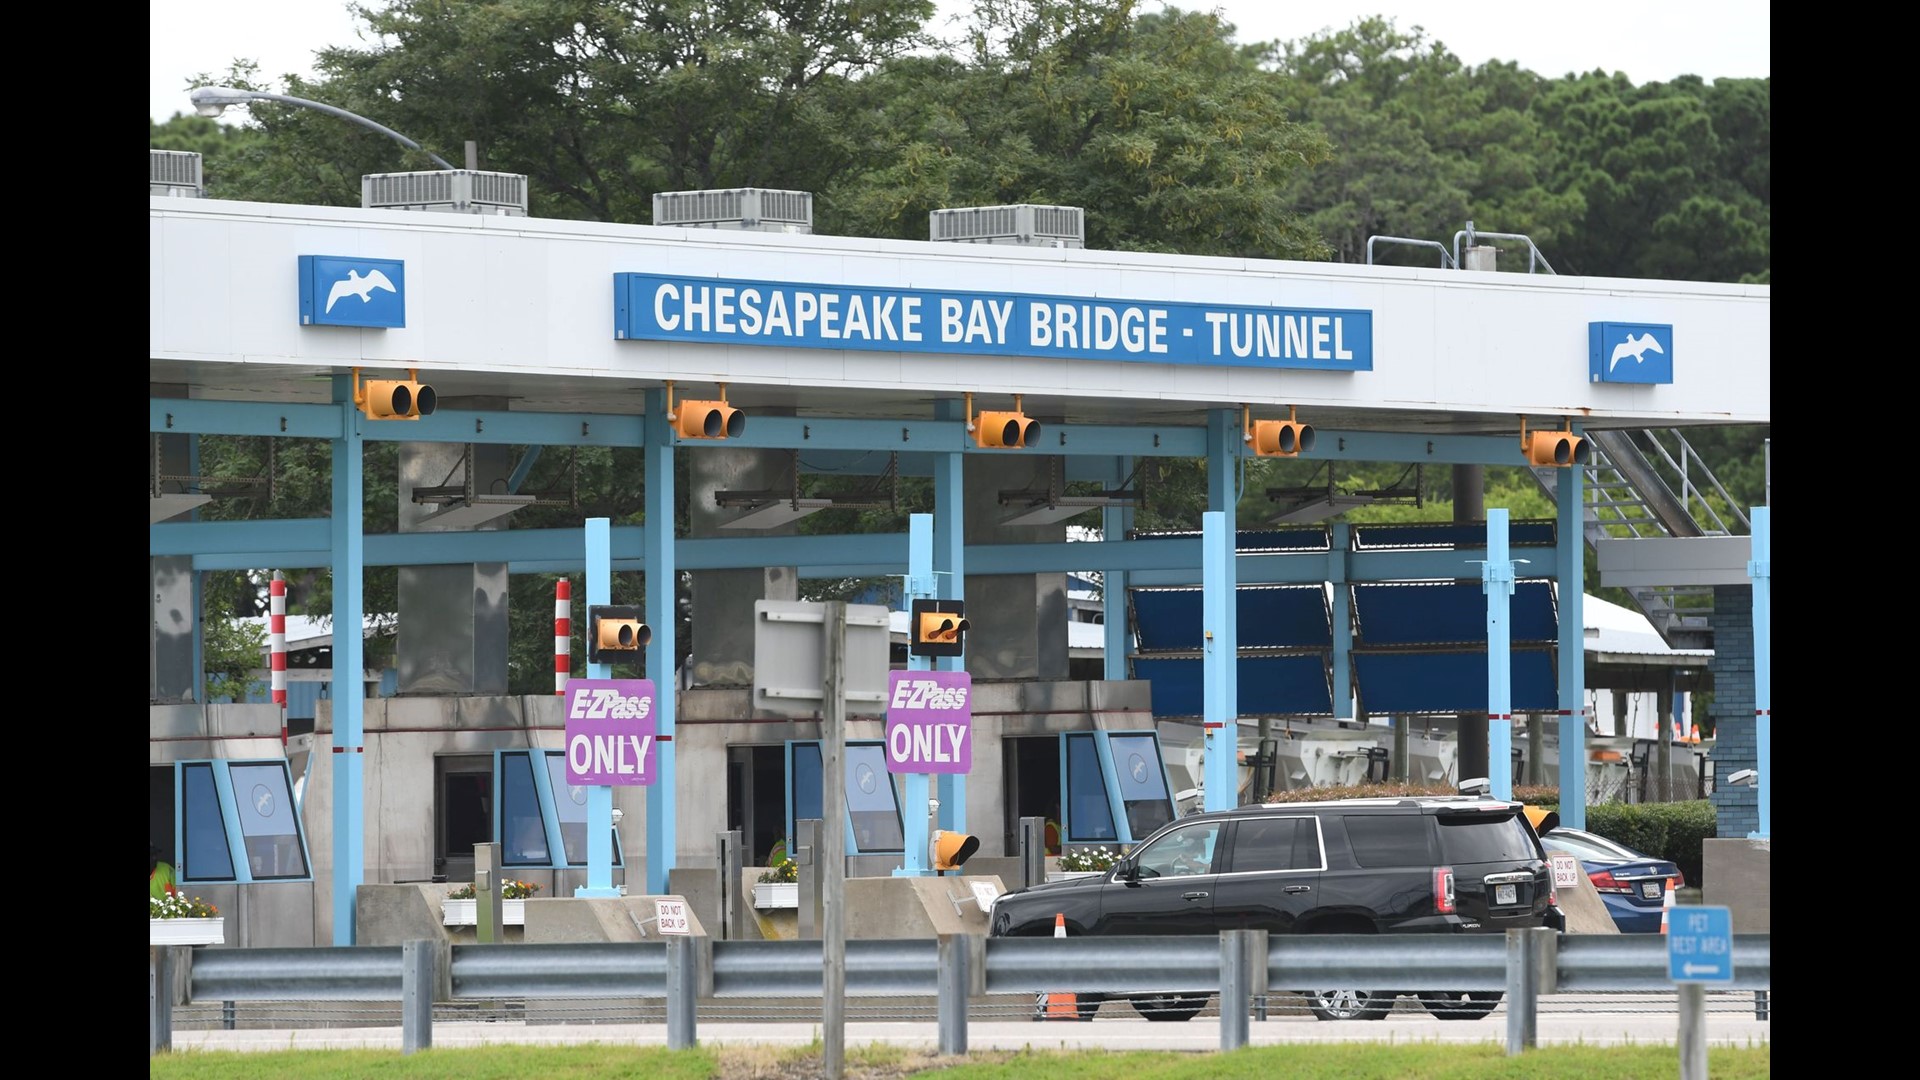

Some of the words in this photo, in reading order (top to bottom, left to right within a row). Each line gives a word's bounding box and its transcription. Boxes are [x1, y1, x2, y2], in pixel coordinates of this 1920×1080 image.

[654, 283, 923, 342] CHESAPEAKE
[940, 298, 1014, 345] BAY
[1030, 302, 1168, 354] BRIDGE
[1205, 312, 1353, 360] TUNNEL
[570, 689, 652, 720] E-ZPass
[891, 679, 967, 710] E-ZPass
[569, 734, 652, 775] ONLY
[891, 723, 967, 763] ONLY
[1556, 861, 1563, 870] DO
[1564, 861, 1573, 870] NOT
[1556, 873, 1568, 882] BACK
[1570, 873, 1576, 882] UP
[660, 905, 669, 915] DO
[671, 905, 682, 916] NOT
[660, 918, 676, 928] BACK
[677, 919, 686, 929] UP
[1672, 935, 1697, 955] REST
[1701, 936, 1728, 955] AREA
